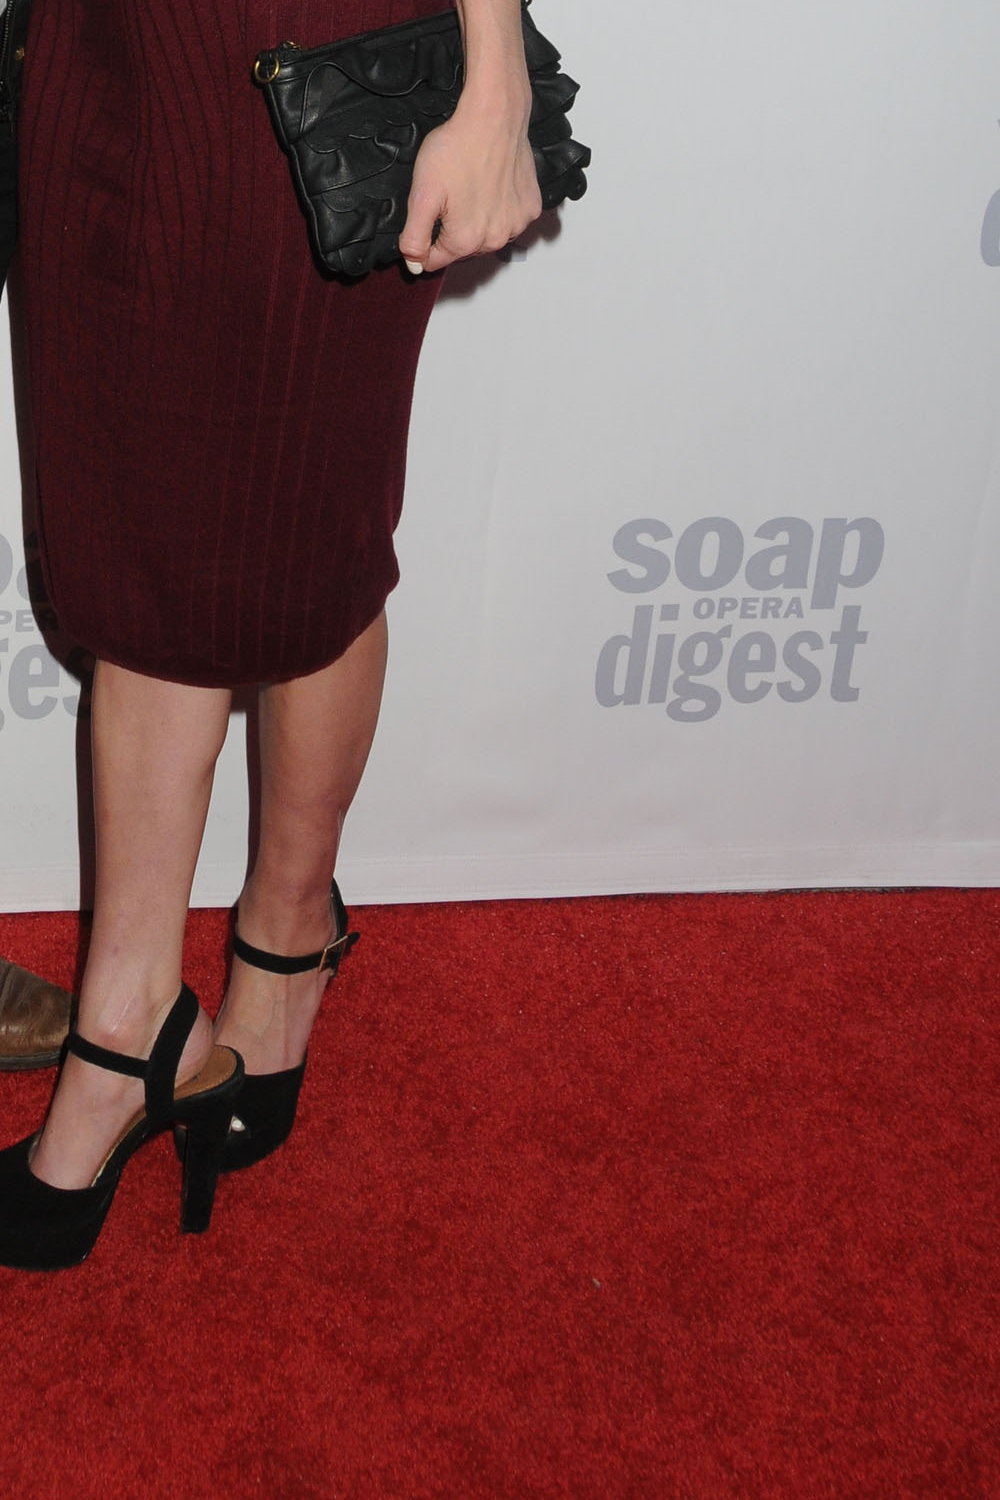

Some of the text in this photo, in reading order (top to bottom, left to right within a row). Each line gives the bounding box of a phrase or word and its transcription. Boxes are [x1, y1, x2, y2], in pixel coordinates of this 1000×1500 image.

[606, 516, 885, 610] soap
[692, 597, 805, 620] OPERA
[595, 604, 868, 724] digest
